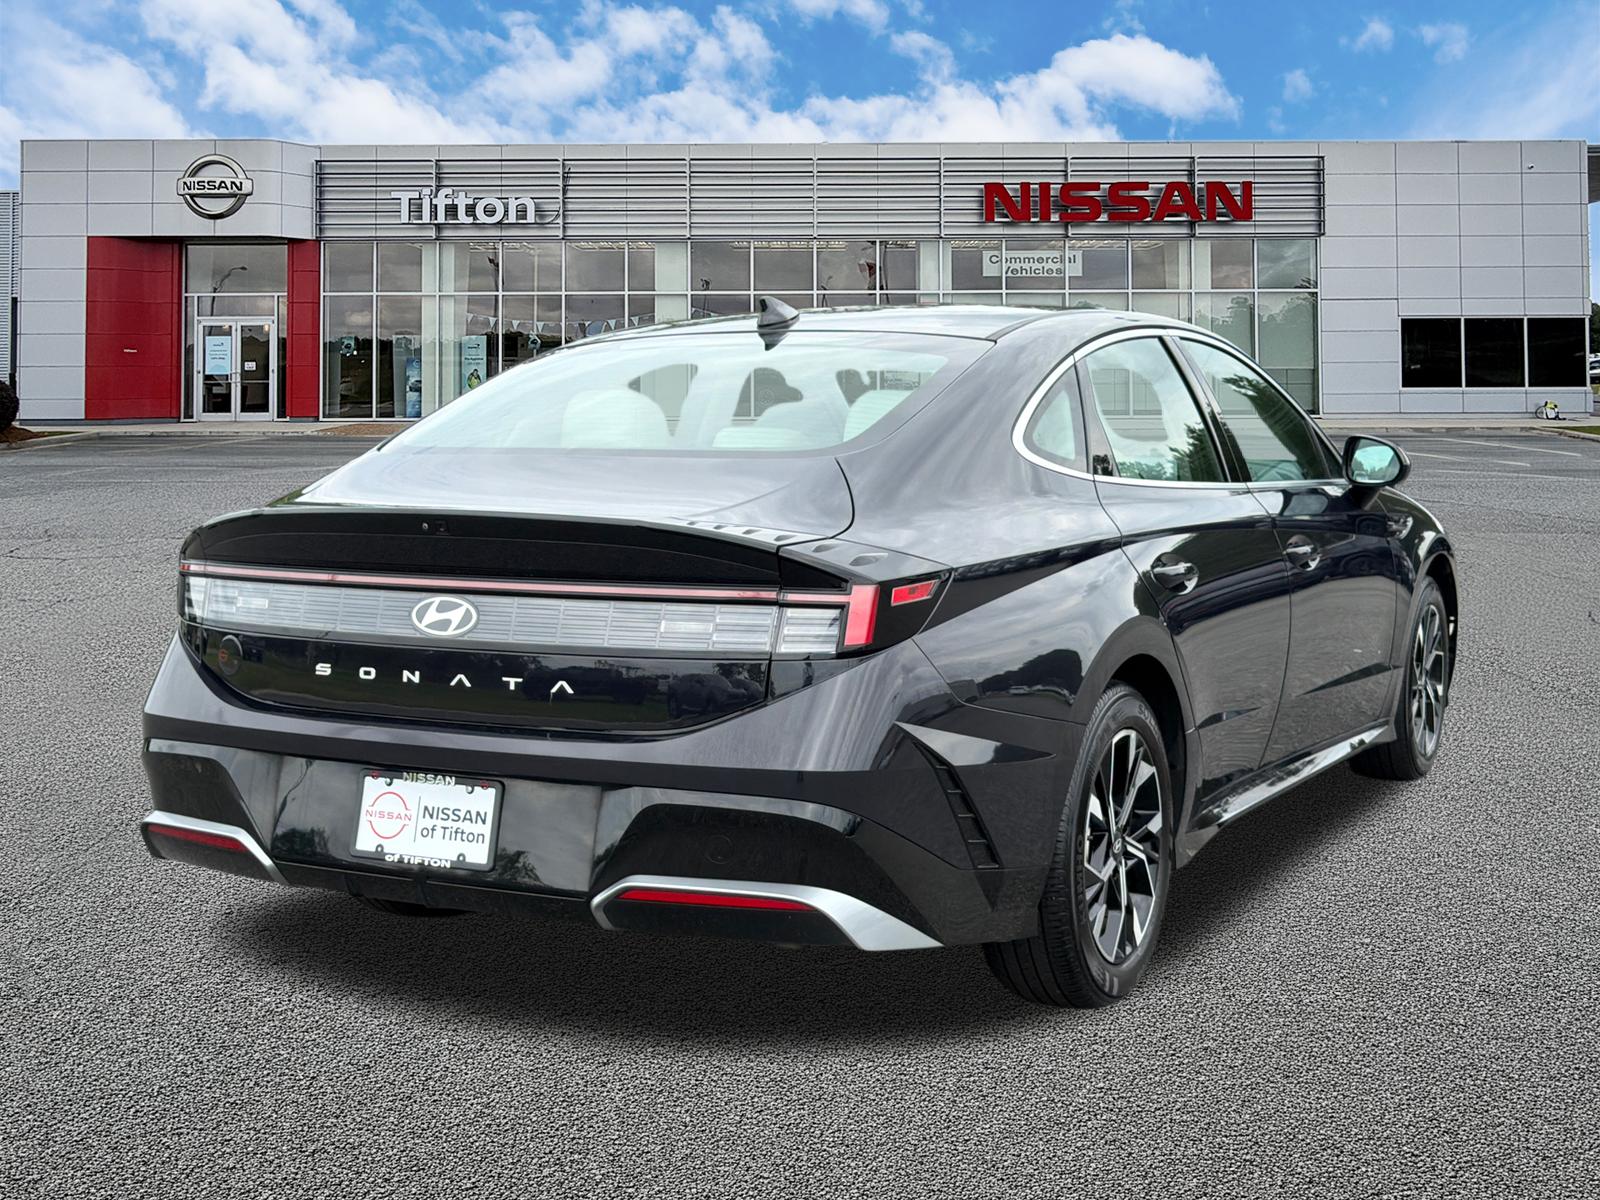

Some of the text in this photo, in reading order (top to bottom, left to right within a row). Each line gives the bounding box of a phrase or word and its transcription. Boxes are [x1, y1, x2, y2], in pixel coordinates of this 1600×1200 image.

[182, 180, 243, 191] NISSAN
[391, 188, 536, 224] Tifton
[983, 181, 1253, 222] NISSAN
[315, 663, 575, 694] SONATA
[402, 772, 456, 786] NISSAN
[365, 809, 412, 822] NISSAN
[422, 805, 488, 825] NISSAN
[420, 825, 486, 844] of Tifton
[384, 854, 451, 868] of TIFTON
